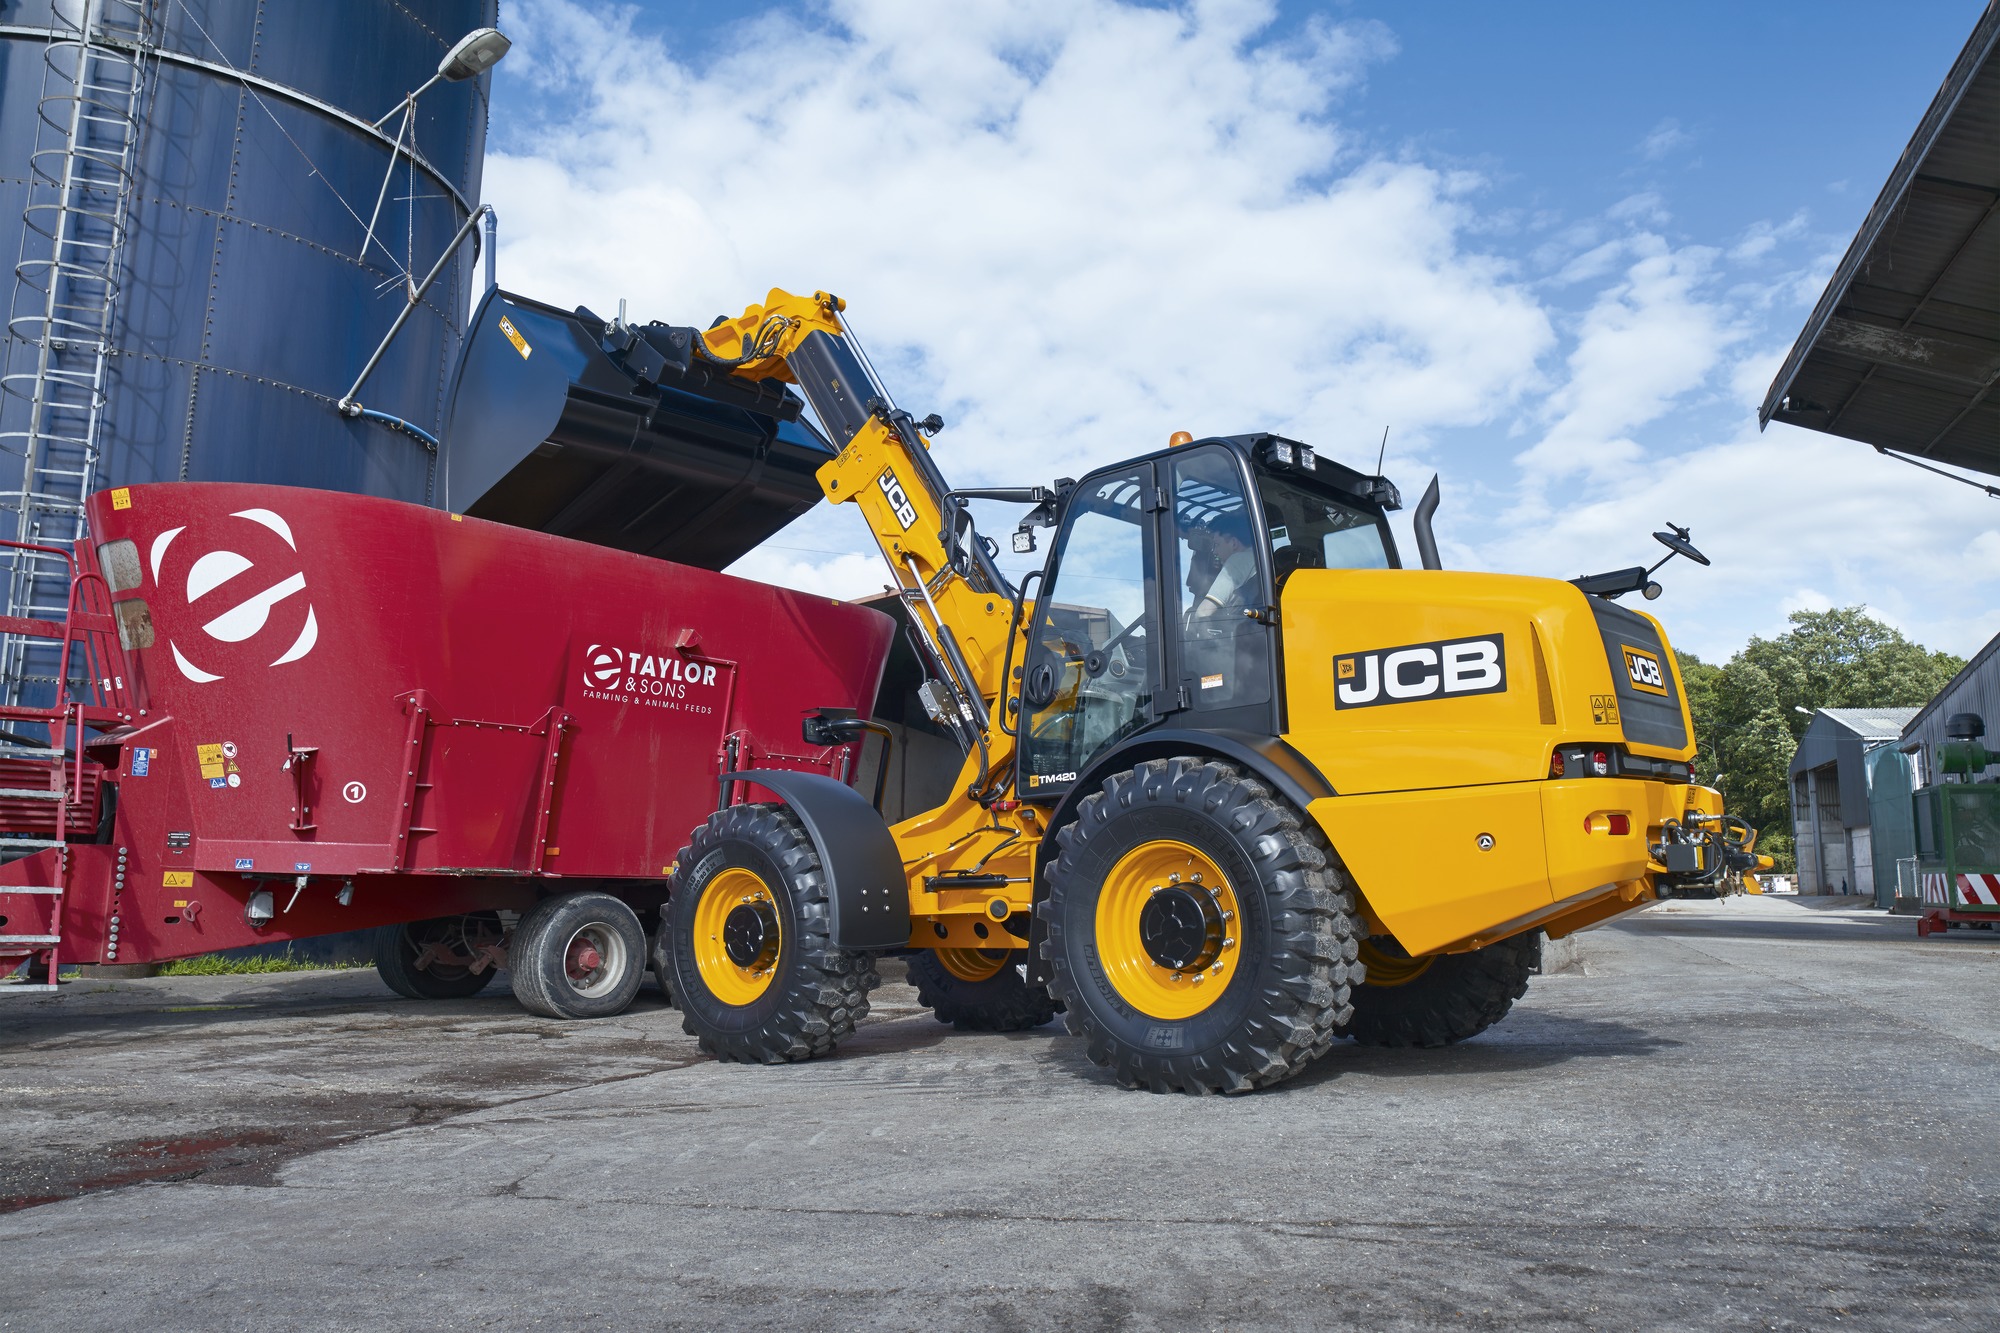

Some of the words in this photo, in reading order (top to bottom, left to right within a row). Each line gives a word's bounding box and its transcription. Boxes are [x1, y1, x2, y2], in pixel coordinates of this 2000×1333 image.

[502, 320, 515, 337] JCB
[879, 475, 916, 529] JCB
[629, 652, 717, 686] TAYLOR
[1338, 640, 1502, 704] JCB
[1630, 655, 1663, 686] JCB
[625, 676, 637, 692] &
[640, 678, 686, 699] SONS
[583, 689, 629, 703] FARMING
[634, 697, 640, 705] &
[645, 699, 680, 710] ANIMAL
[684, 704, 713, 715] FEEDS
[350, 785, 359, 799] 1
[1038, 771, 1077, 785] TM420
[1083, 943, 1121, 1014] MICHELIN
